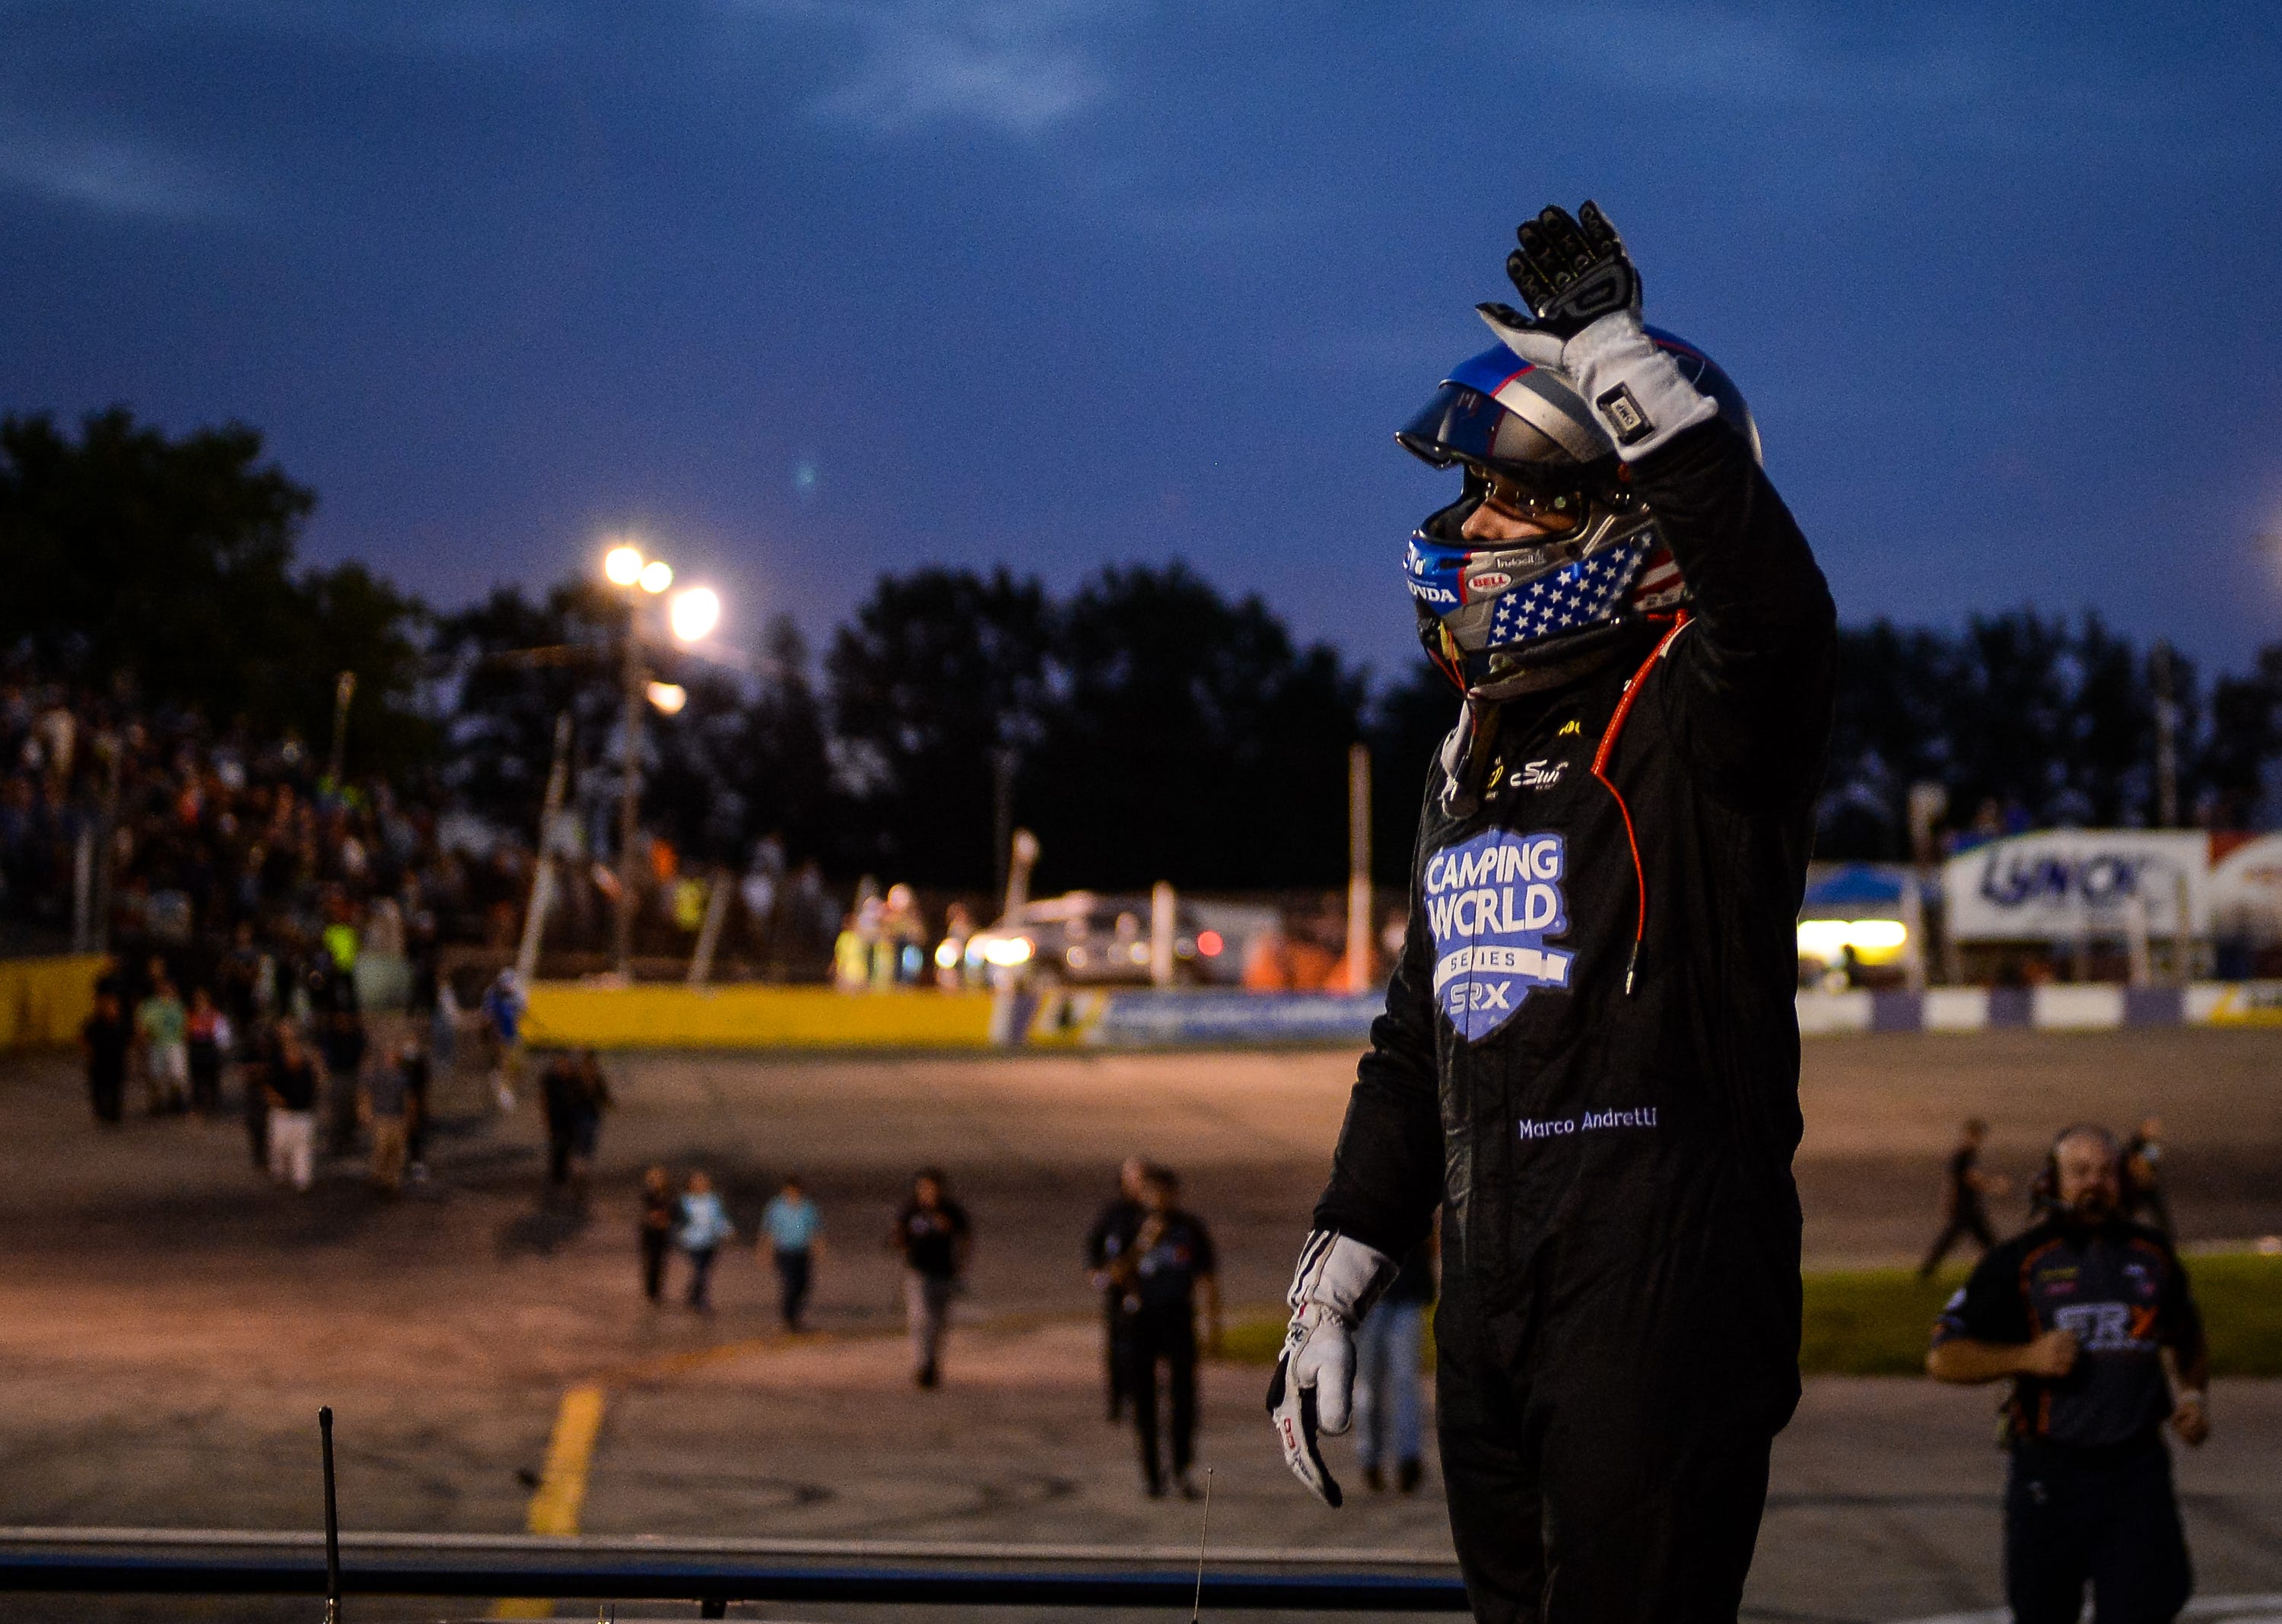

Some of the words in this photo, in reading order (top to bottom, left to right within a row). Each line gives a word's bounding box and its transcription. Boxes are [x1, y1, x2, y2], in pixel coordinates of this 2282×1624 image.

[1407, 580, 1457, 603] ONDA
[1473, 575, 1506, 587] BELL
[1427, 840, 1558, 895] CAMPING
[1428, 883, 1557, 943] WORLD
[1451, 952, 1515, 972] SEIES
[1450, 980, 1511, 1015] SRX
[1519, 1119, 1575, 1139] Marco
[1581, 1108, 1657, 1131] Andretti
